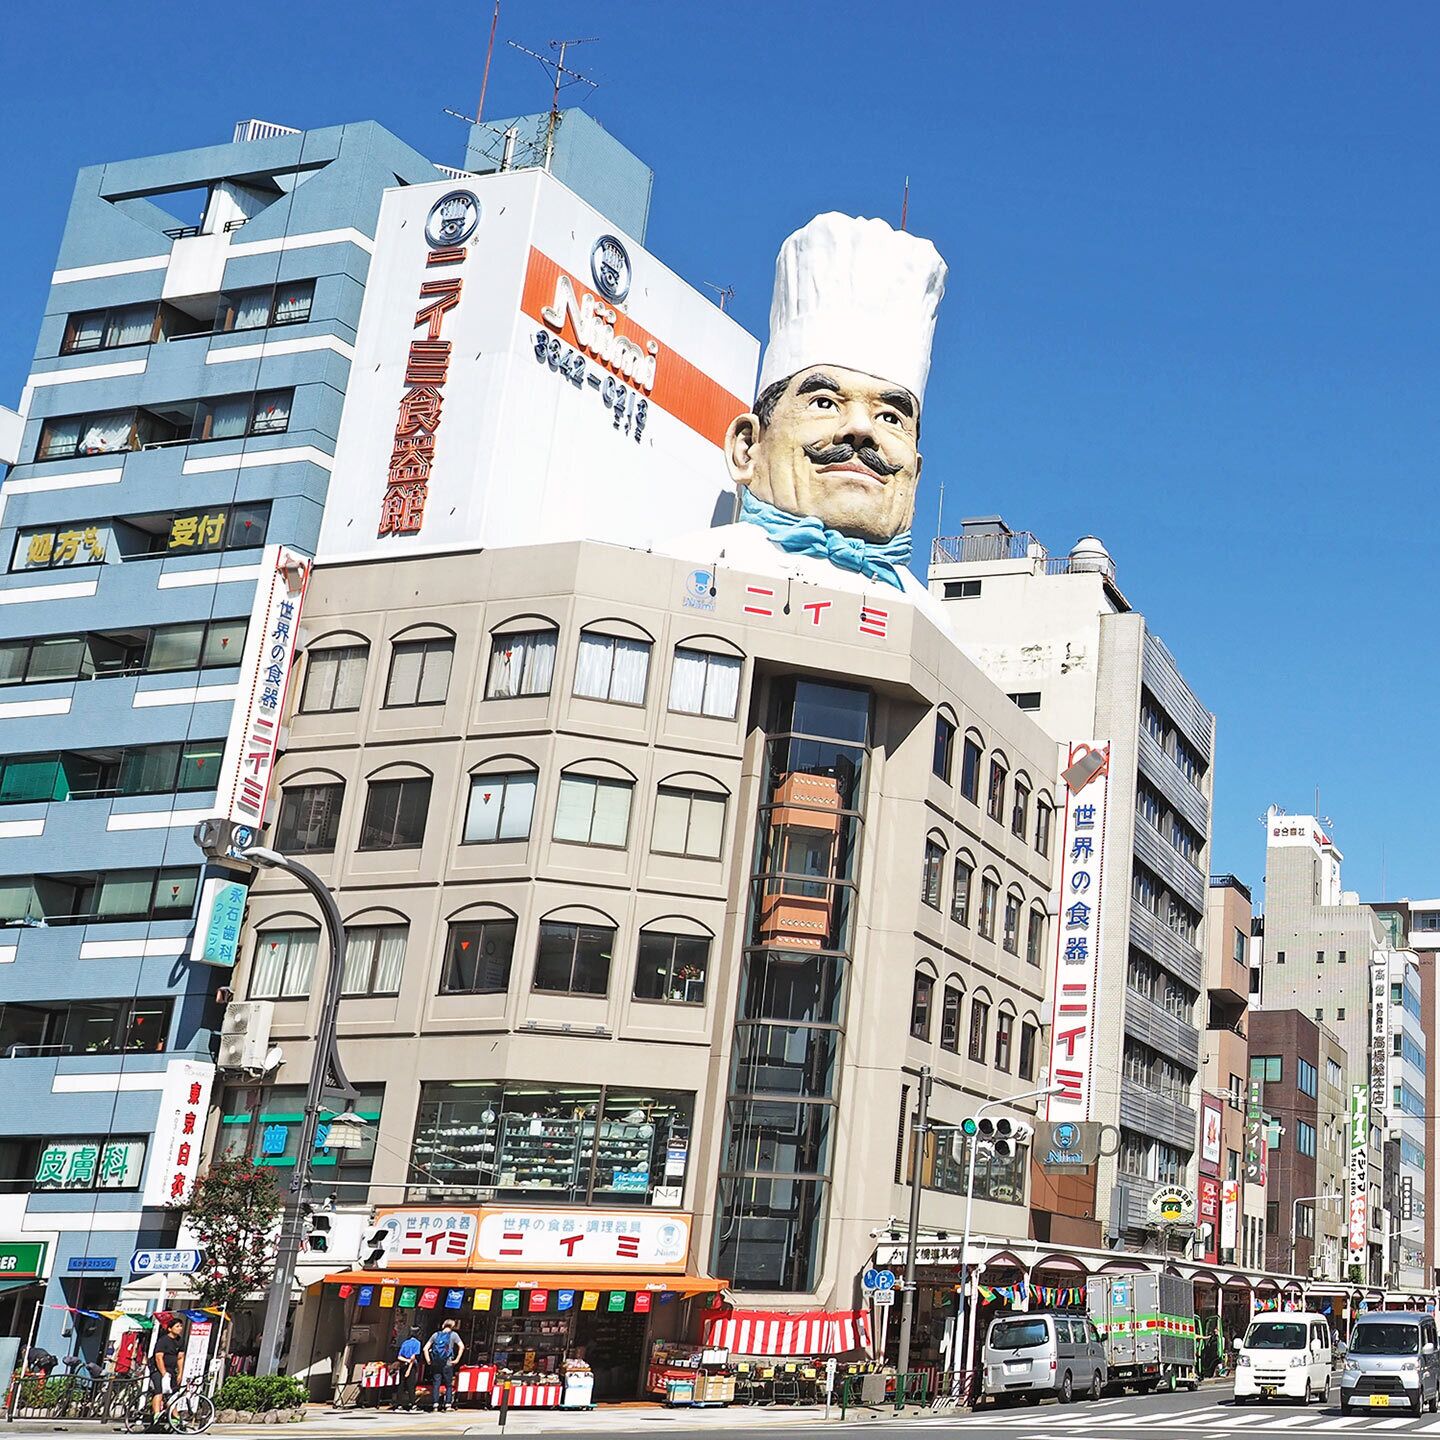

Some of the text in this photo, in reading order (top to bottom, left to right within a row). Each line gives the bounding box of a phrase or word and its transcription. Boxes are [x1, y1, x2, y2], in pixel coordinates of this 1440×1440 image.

[540, 274, 659, 393] Niimi
[380, 246, 467, 538] ニイミ食器館
[26, 511, 226, 563] 処方せん 受付
[744, 586, 888, 638] ニイミ
[260, 599, 296, 710] 世界の食器
[237, 719, 275, 811] ニイミ
[206, 902, 223, 957] クリニック
[219, 887, 244, 961] 永石歯科
[1055, 803, 1096, 1101] 世界の食器 ニイミ
[35, 1146, 129, 1183] 皮膚科
[170, 1081, 202, 1199] 東京白衣
[655, 1188, 680, 1199] N4
[401, 1231, 469, 1256] ニイミ
[405, 1216, 471, 1230] 世界の食器
[498, 1233, 641, 1259] ニイミ
[502, 1217, 642, 1234] 世界の食器・調理器具
[154, 1252, 191, 1263] 浅草通り
